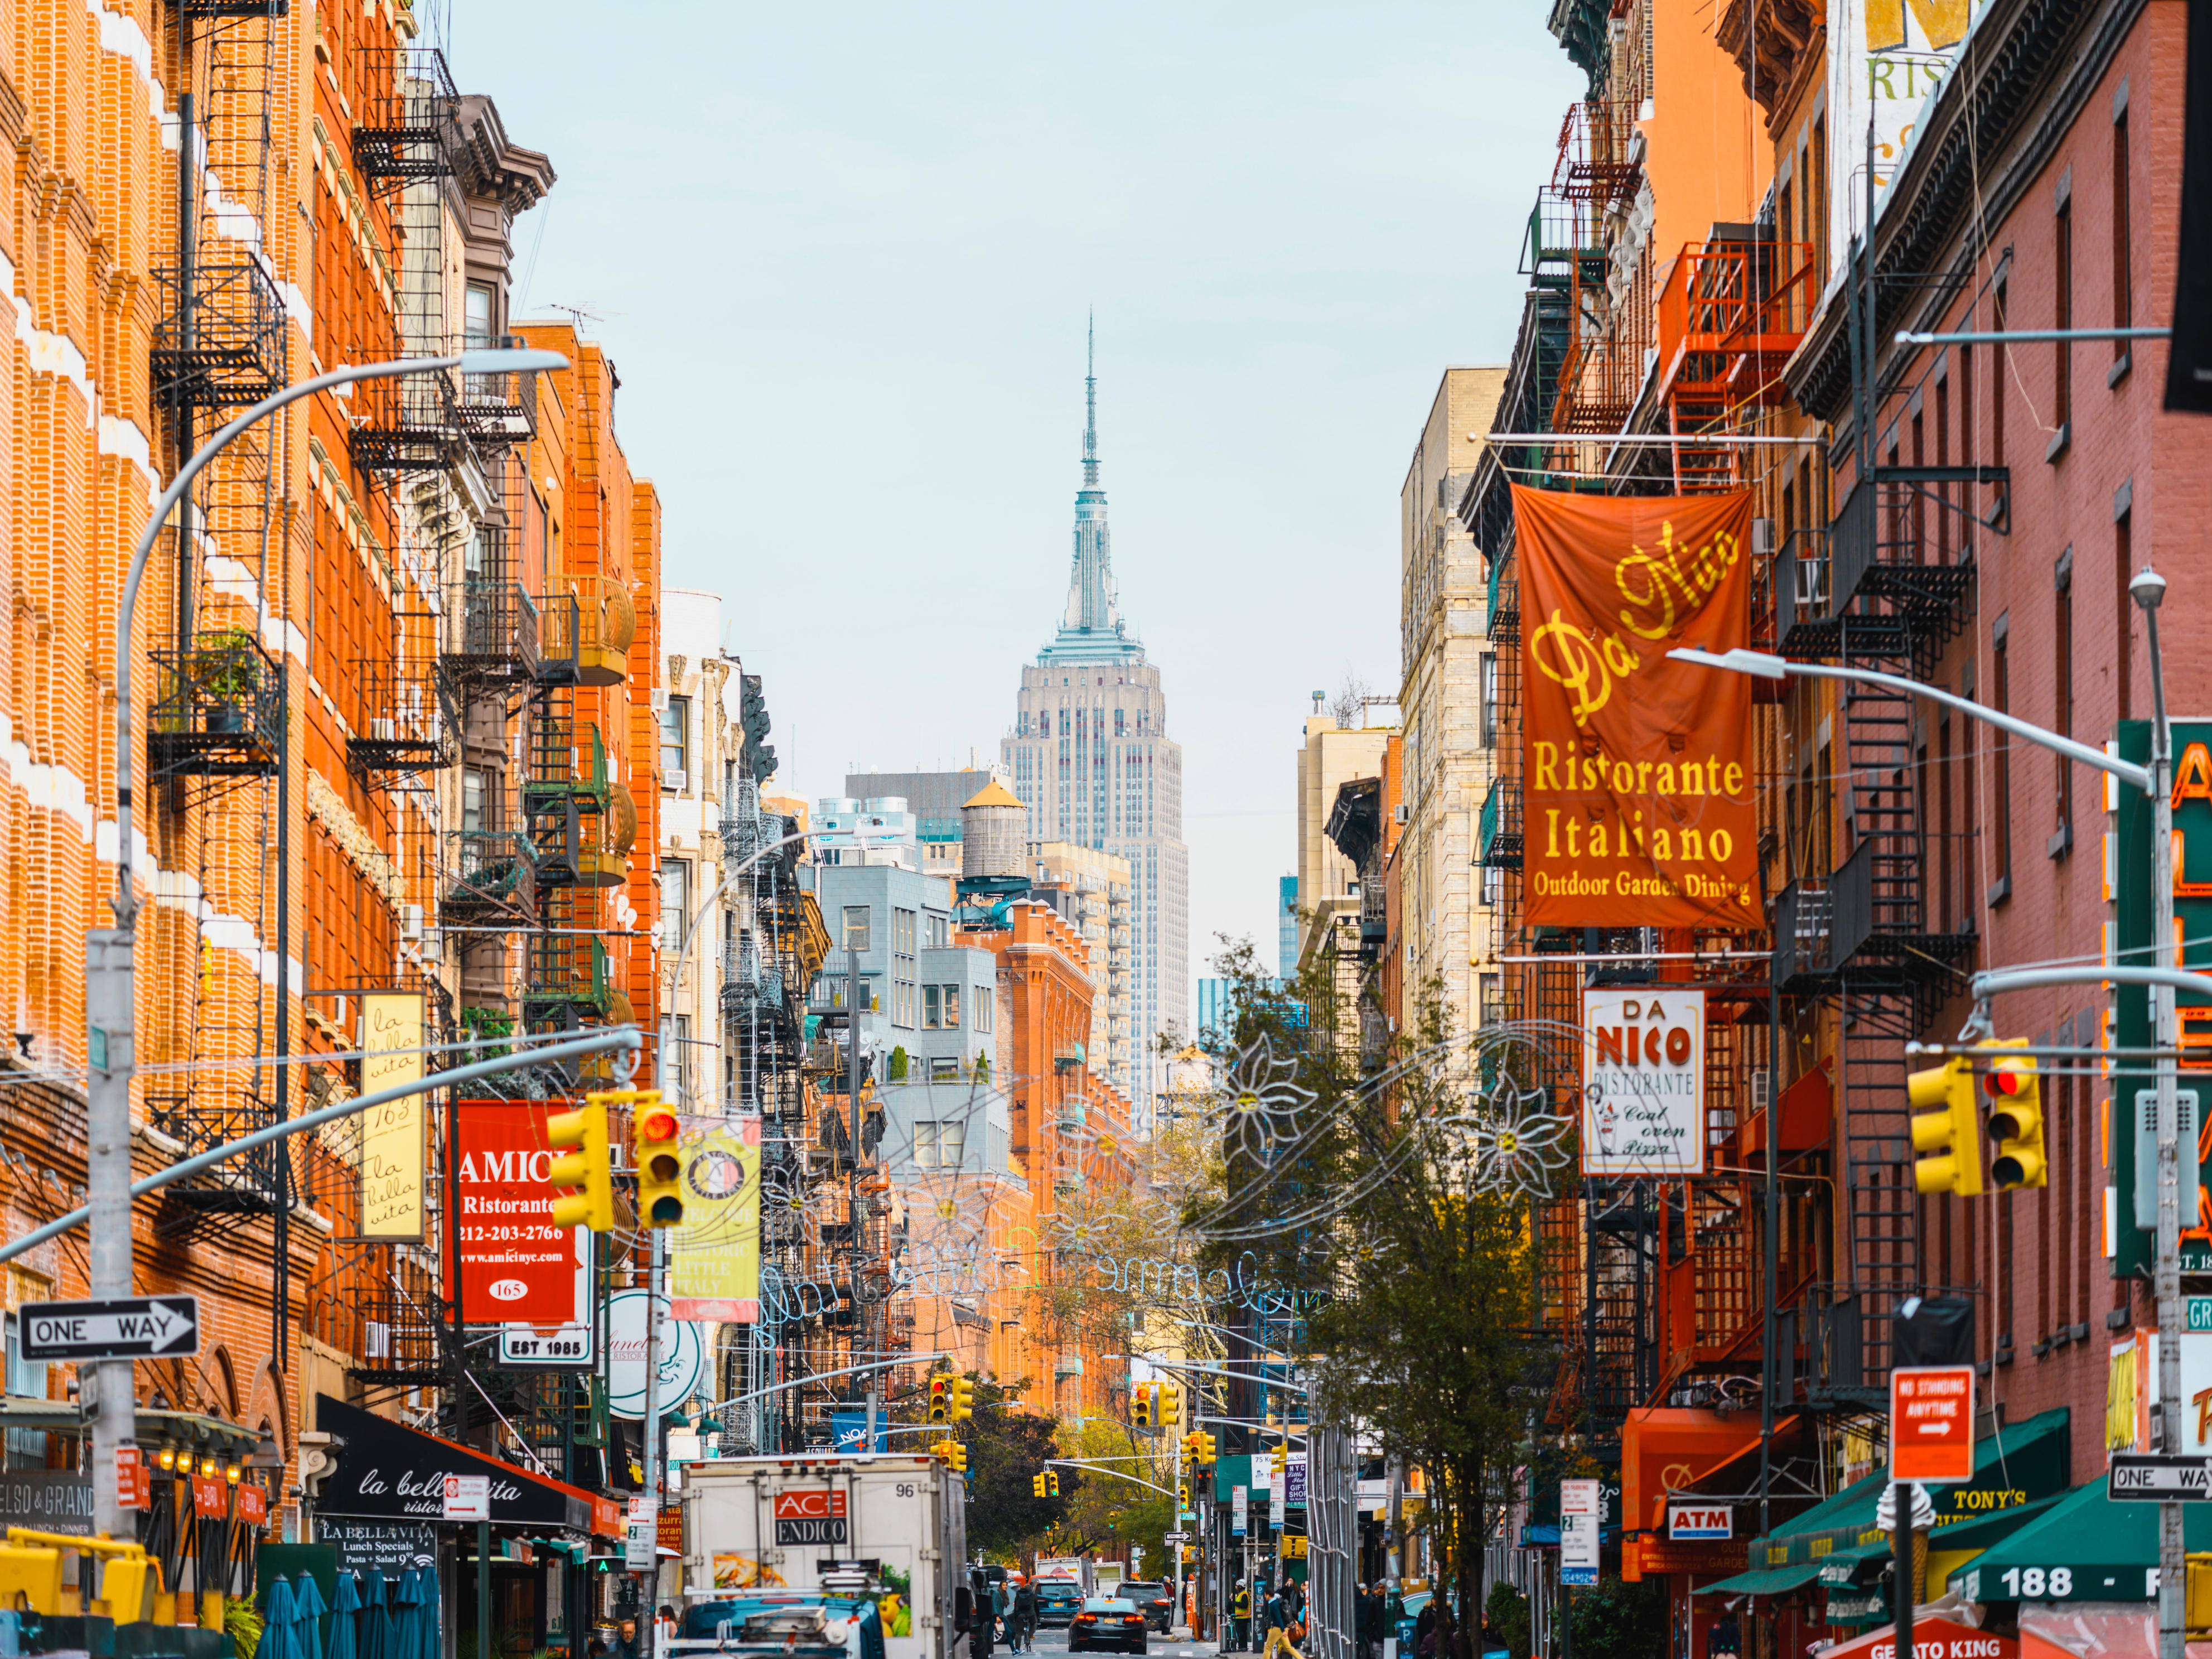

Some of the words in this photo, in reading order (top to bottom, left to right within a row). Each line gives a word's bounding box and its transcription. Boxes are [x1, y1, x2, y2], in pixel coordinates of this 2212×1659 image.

[1531, 608, 1640, 727] Da
[1615, 520, 1739, 640] Nico
[1533, 741, 1743, 795] Ristorante
[1545, 809, 1732, 861] Italiano
[1534, 871, 1610, 896] Outdoor
[1616, 871, 1682, 896] Garden
[1686, 875, 1750, 906] Dining
[1623, 1000, 1665, 1020] DA
[374, 1008, 403, 1032] la
[1597, 1026, 1691, 1066] NICO
[371, 1058, 415, 1079] vita
[1594, 1073, 1694, 1096] RISTORANTE
[375, 1097, 410, 1129] 163
[1624, 1105, 1668, 1122] Coal
[1642, 1124, 1687, 1138] oven
[1623, 1140, 1670, 1158] Pizza
[374, 1154, 403, 1179] la
[459, 1150, 568, 1183] AMIC
[368, 1177, 417, 1206] bella
[463, 1196, 556, 1214] Ristorante
[370, 1204, 415, 1226] vita
[676, 1243, 750, 1256] HISTORIC
[676, 1262, 730, 1276] LITTLE
[498, 1284, 520, 1296] 165
[676, 1280, 721, 1294] ITALY
[36, 1320, 86, 1342] ONE
[118, 1316, 172, 1338] WAY
[511, 1341, 539, 1354] EST
[547, 1342, 580, 1355] 1985
[1899, 1380, 1915, 1396] NO
[1918, 1378, 1966, 1396] STANDING
[1906, 1400, 1958, 1417] ANYTIME
[359, 1469, 388, 1495] la
[397, 1470, 452, 1497] bell
[488, 1480, 521, 1501] ita
[2118, 1469, 2154, 1487] ONE
[896, 1484, 914, 1498] 96
[1954, 1489, 2026, 1508] TONY'S
[34, 1491, 42, 1508] &
[45, 1486, 94, 1516] GRAND
[403, 1501, 446, 1513] ristor
[778, 1494, 844, 1515] ACE
[29, 1524, 54, 1532] LUNCH
[61, 1524, 89, 1534] DINNER
[1564, 1517, 1571, 1531] 2
[1674, 1511, 1727, 1528] ATM
[322, 1527, 342, 1539] LA
[346, 1527, 398, 1539] BELLA
[399, 1527, 434, 1539] VITA
[630, 1527, 636, 1539] 2
[778, 1521, 845, 1542] ENDICO
[343, 1542, 373, 1551] Lunch
[375, 1541, 414, 1552] Specials
[2001, 1567, 2073, 1597] 188
[1403, 1629, 1410, 1641] P
[1871, 1642, 1944, 1659] GEATO
[1950, 1639, 2000, 1658] KING
